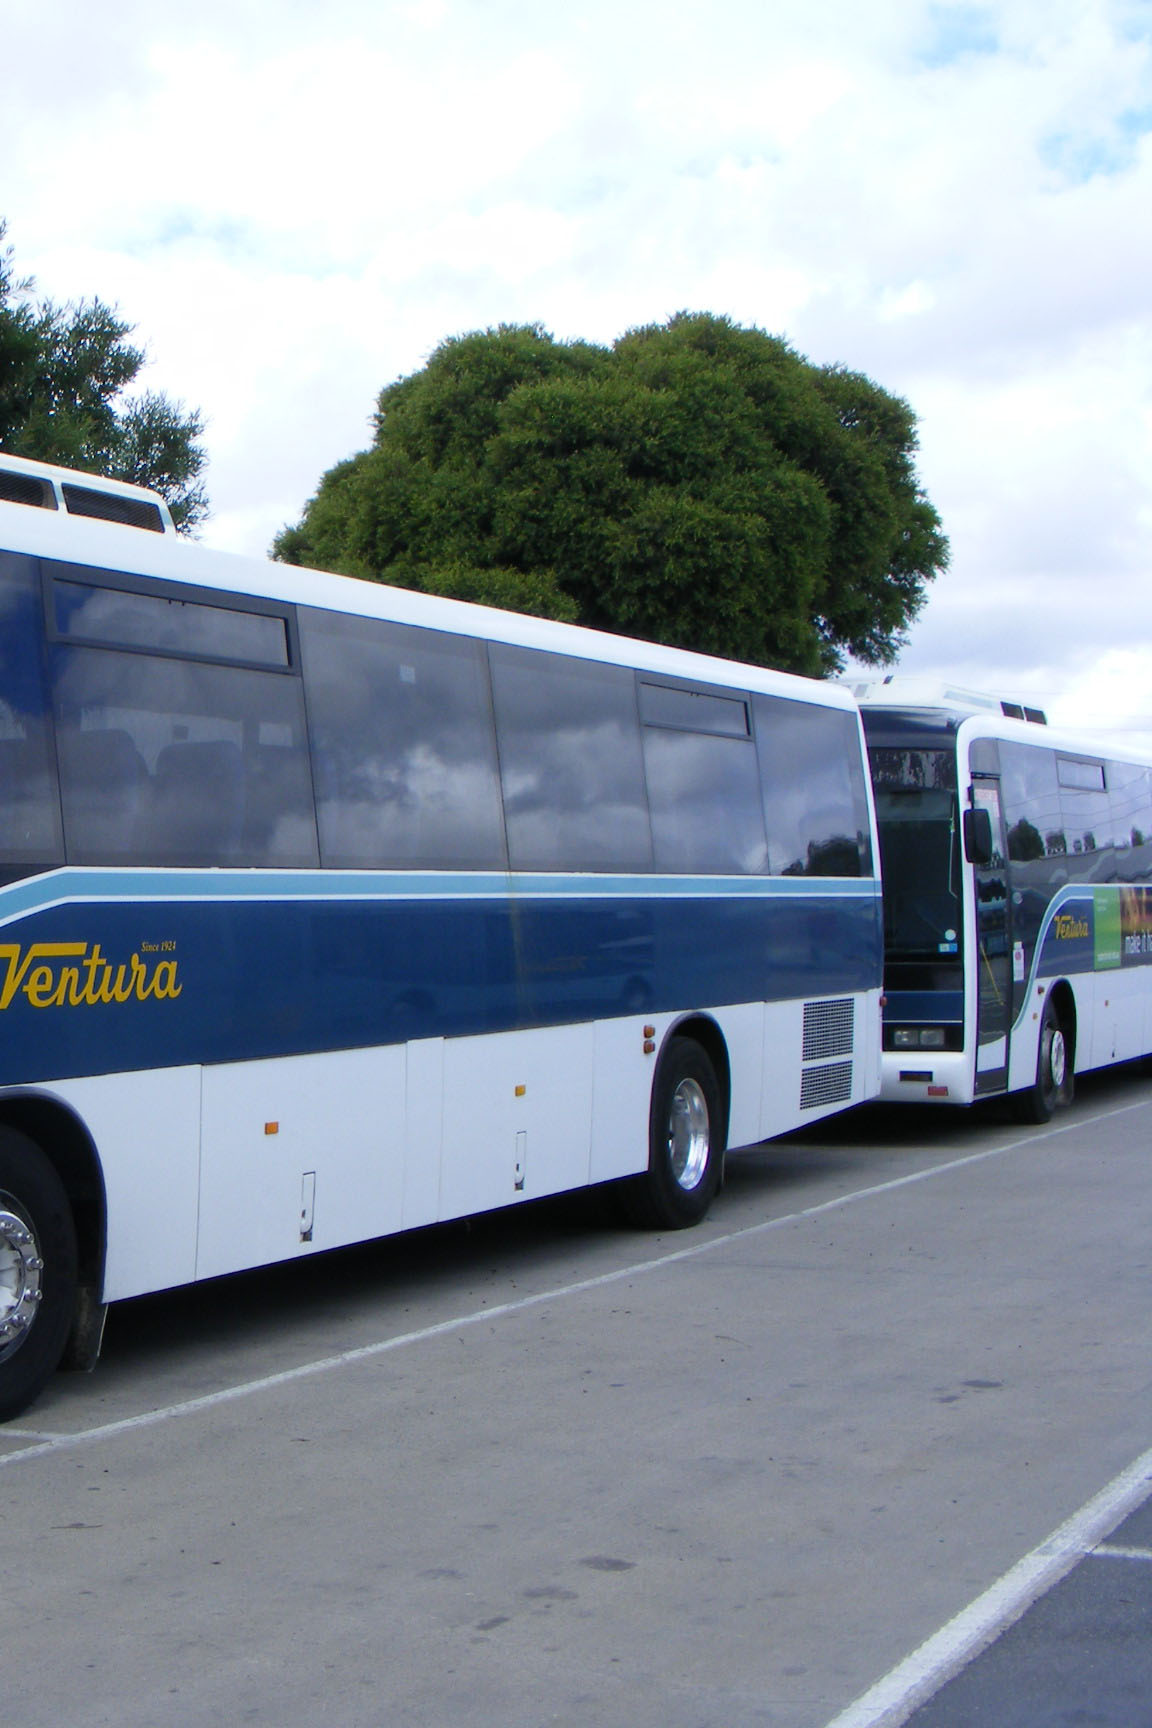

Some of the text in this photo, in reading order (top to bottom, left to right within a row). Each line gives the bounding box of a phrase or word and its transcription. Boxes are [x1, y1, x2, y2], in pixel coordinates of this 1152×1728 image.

[1054, 915, 1089, 939] Ventura
[141, 941, 176, 952] Since 1924
